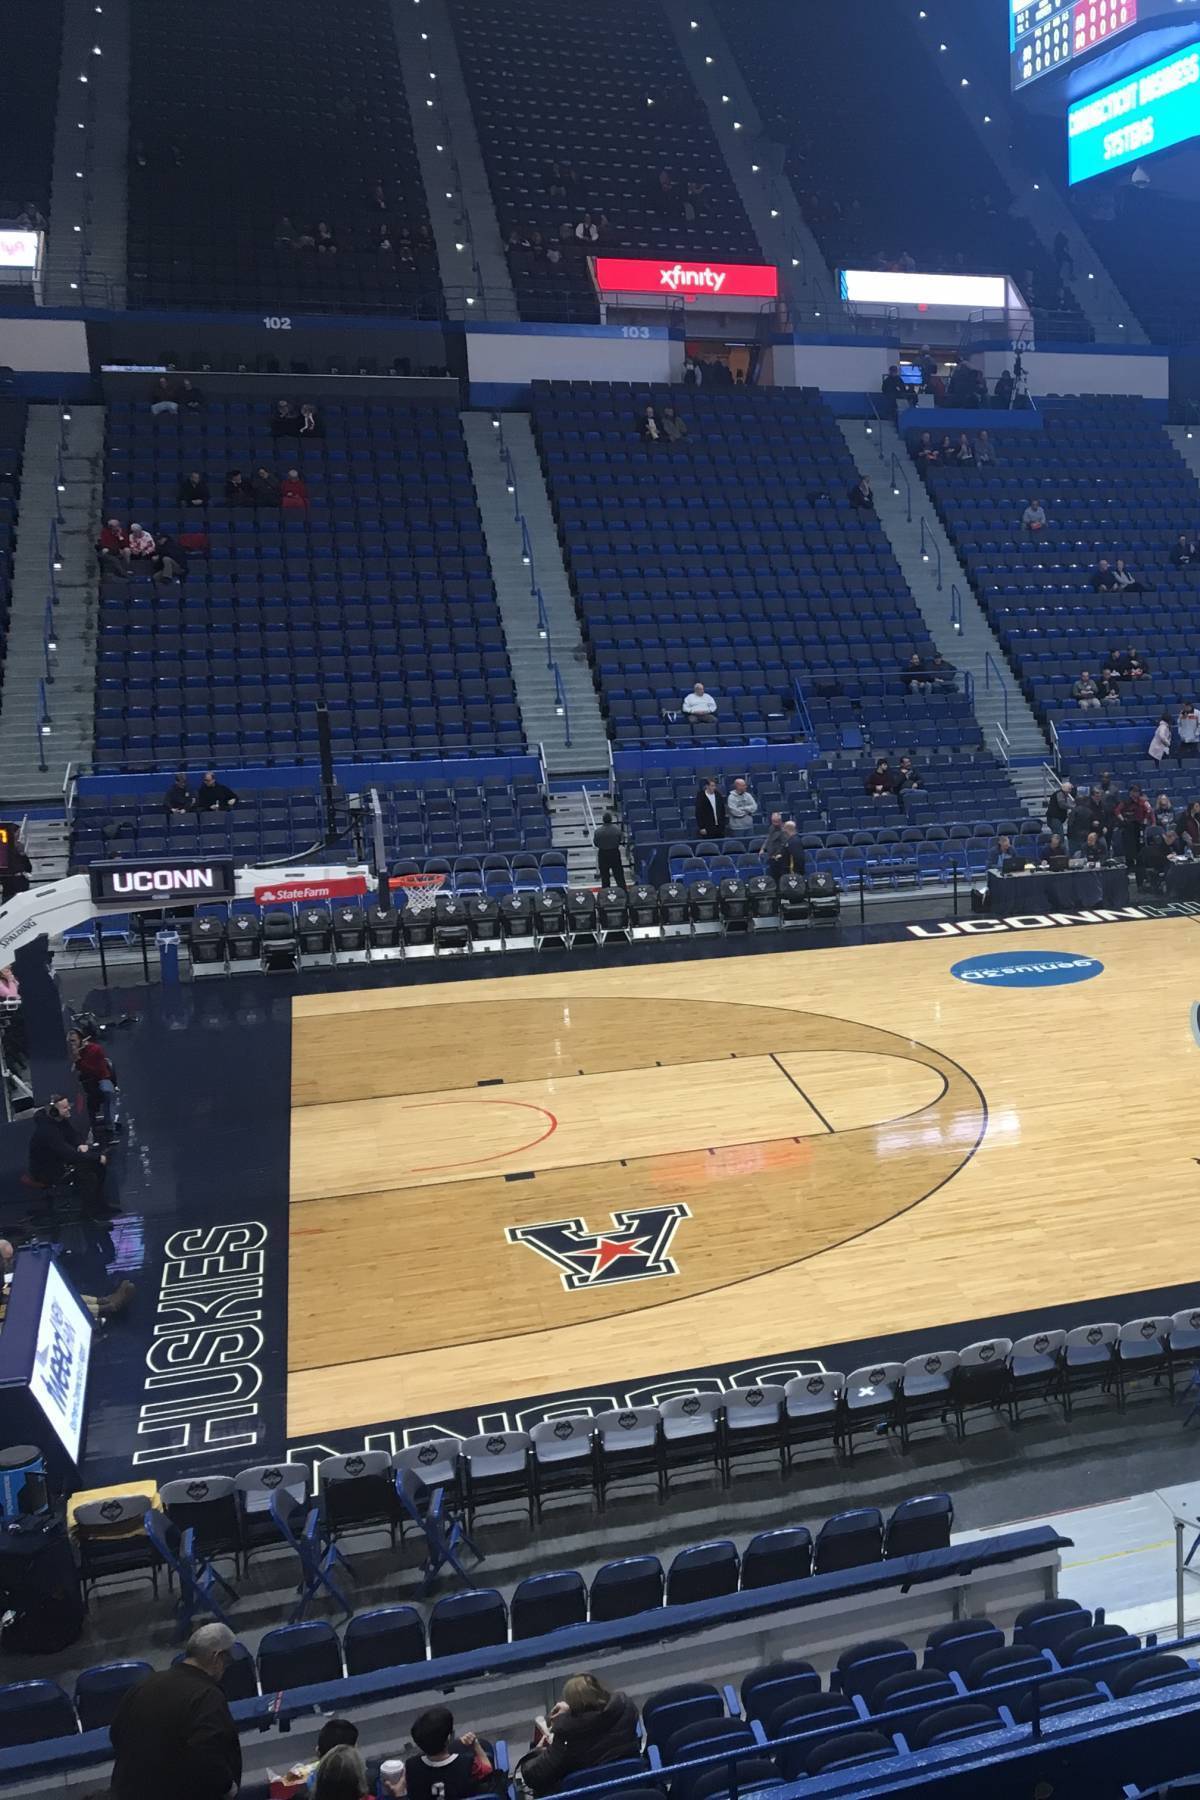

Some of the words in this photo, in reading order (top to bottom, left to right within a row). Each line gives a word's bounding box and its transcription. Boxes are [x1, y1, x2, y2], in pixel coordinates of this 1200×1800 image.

[660, 264, 727, 292] xfinity
[263, 317, 292, 330] 102
[622, 326, 650, 339] 103
[112, 868, 212, 892] UCONN
[907, 906, 1153, 939] UCONN
[961, 958, 1094, 981] genius3D
[132, 1221, 268, 1465] HUSKIES
